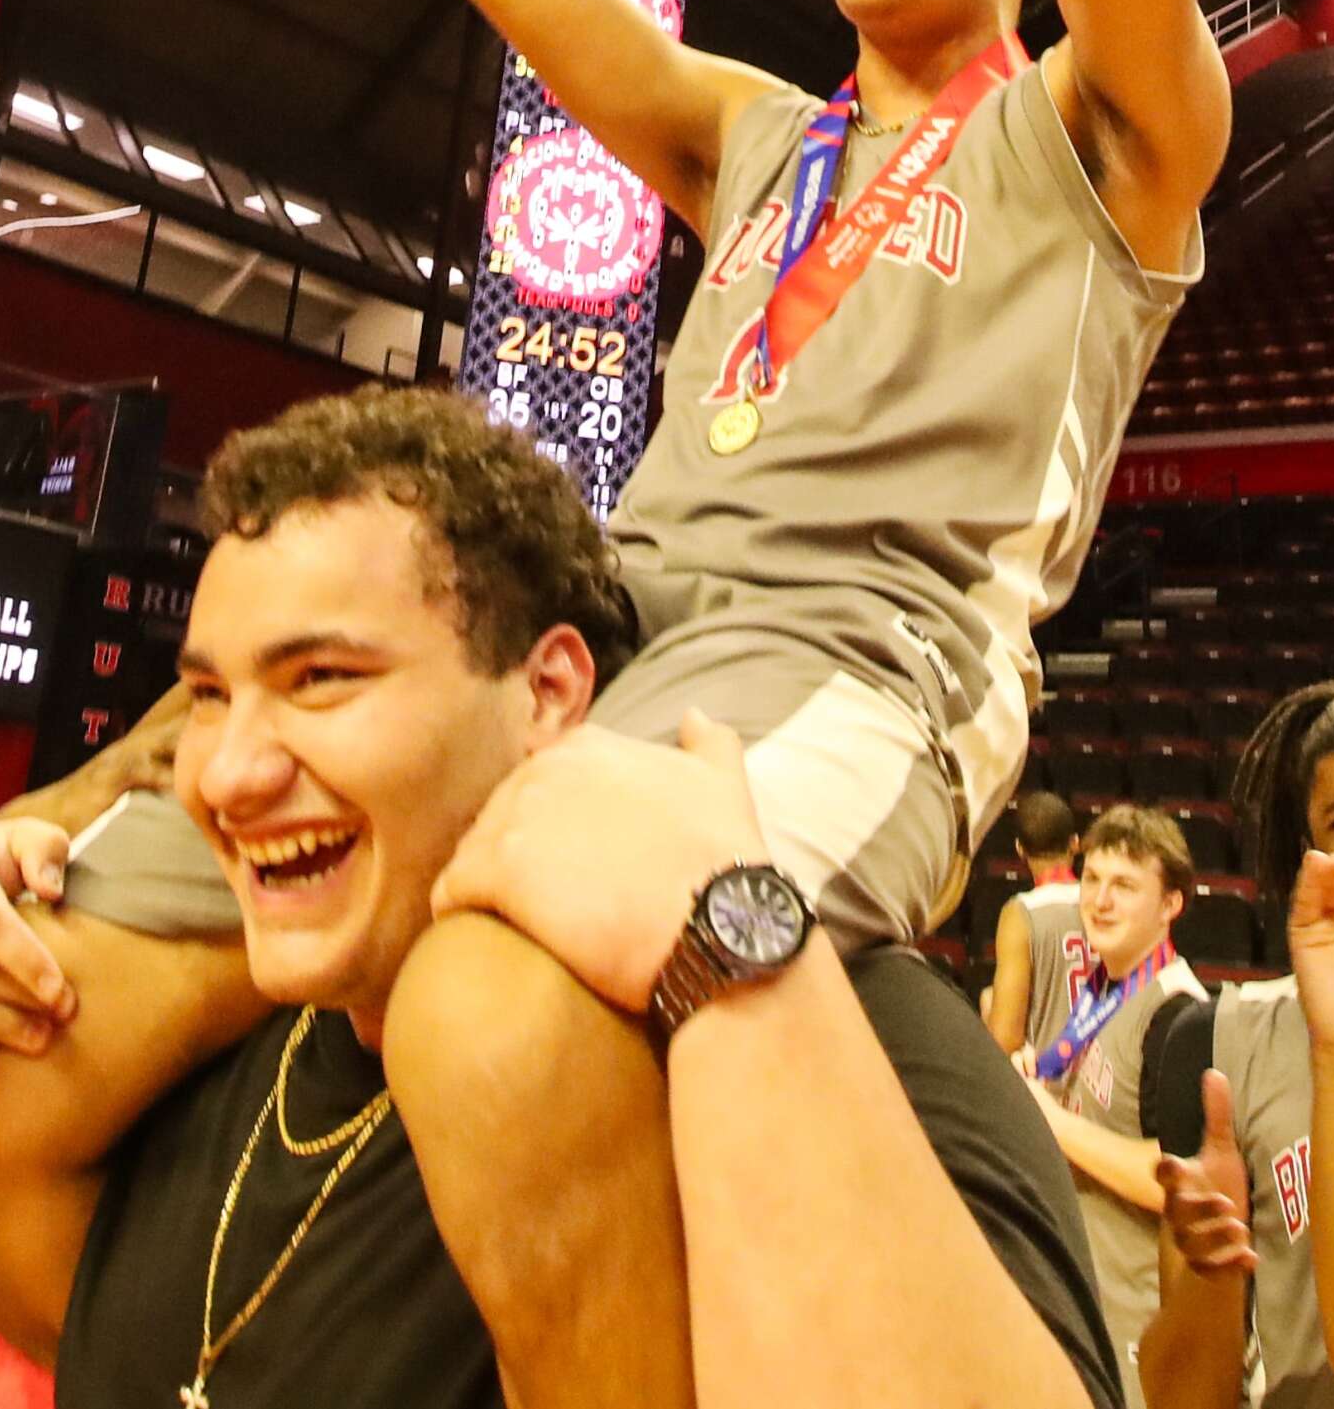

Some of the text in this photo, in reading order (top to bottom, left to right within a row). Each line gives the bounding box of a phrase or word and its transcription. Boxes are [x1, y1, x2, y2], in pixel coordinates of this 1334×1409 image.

[496, 316, 627, 376] 24:52
[578, 401, 623, 442] 20
[1123, 464, 1181, 496] 116
[141, 582, 193, 620] RU
